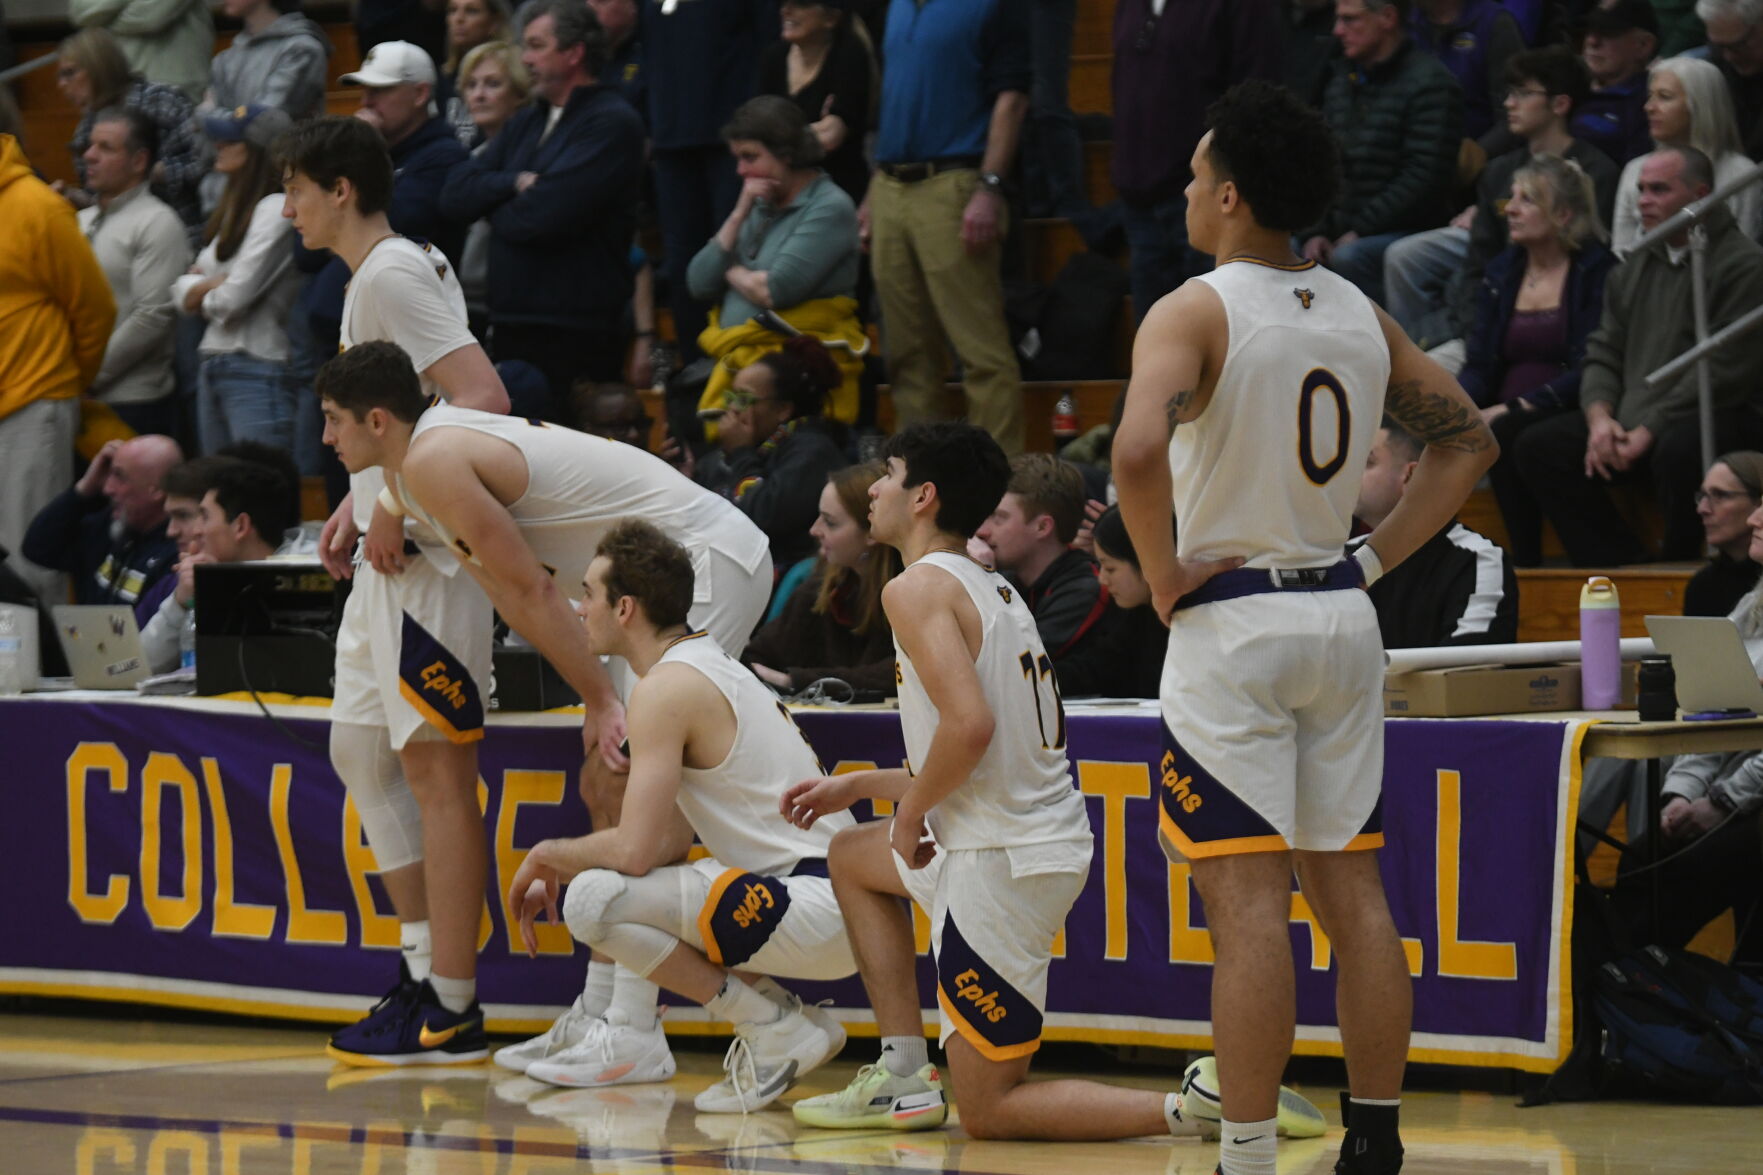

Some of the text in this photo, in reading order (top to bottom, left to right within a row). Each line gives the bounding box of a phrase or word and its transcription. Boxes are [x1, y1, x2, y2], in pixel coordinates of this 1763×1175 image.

[1297, 366, 1351, 487] 0
[420, 660, 467, 710] Ephs
[1160, 749, 1203, 814] Ephs
[732, 882, 775, 929] Ephs
[954, 967, 1008, 1023] Ephs
